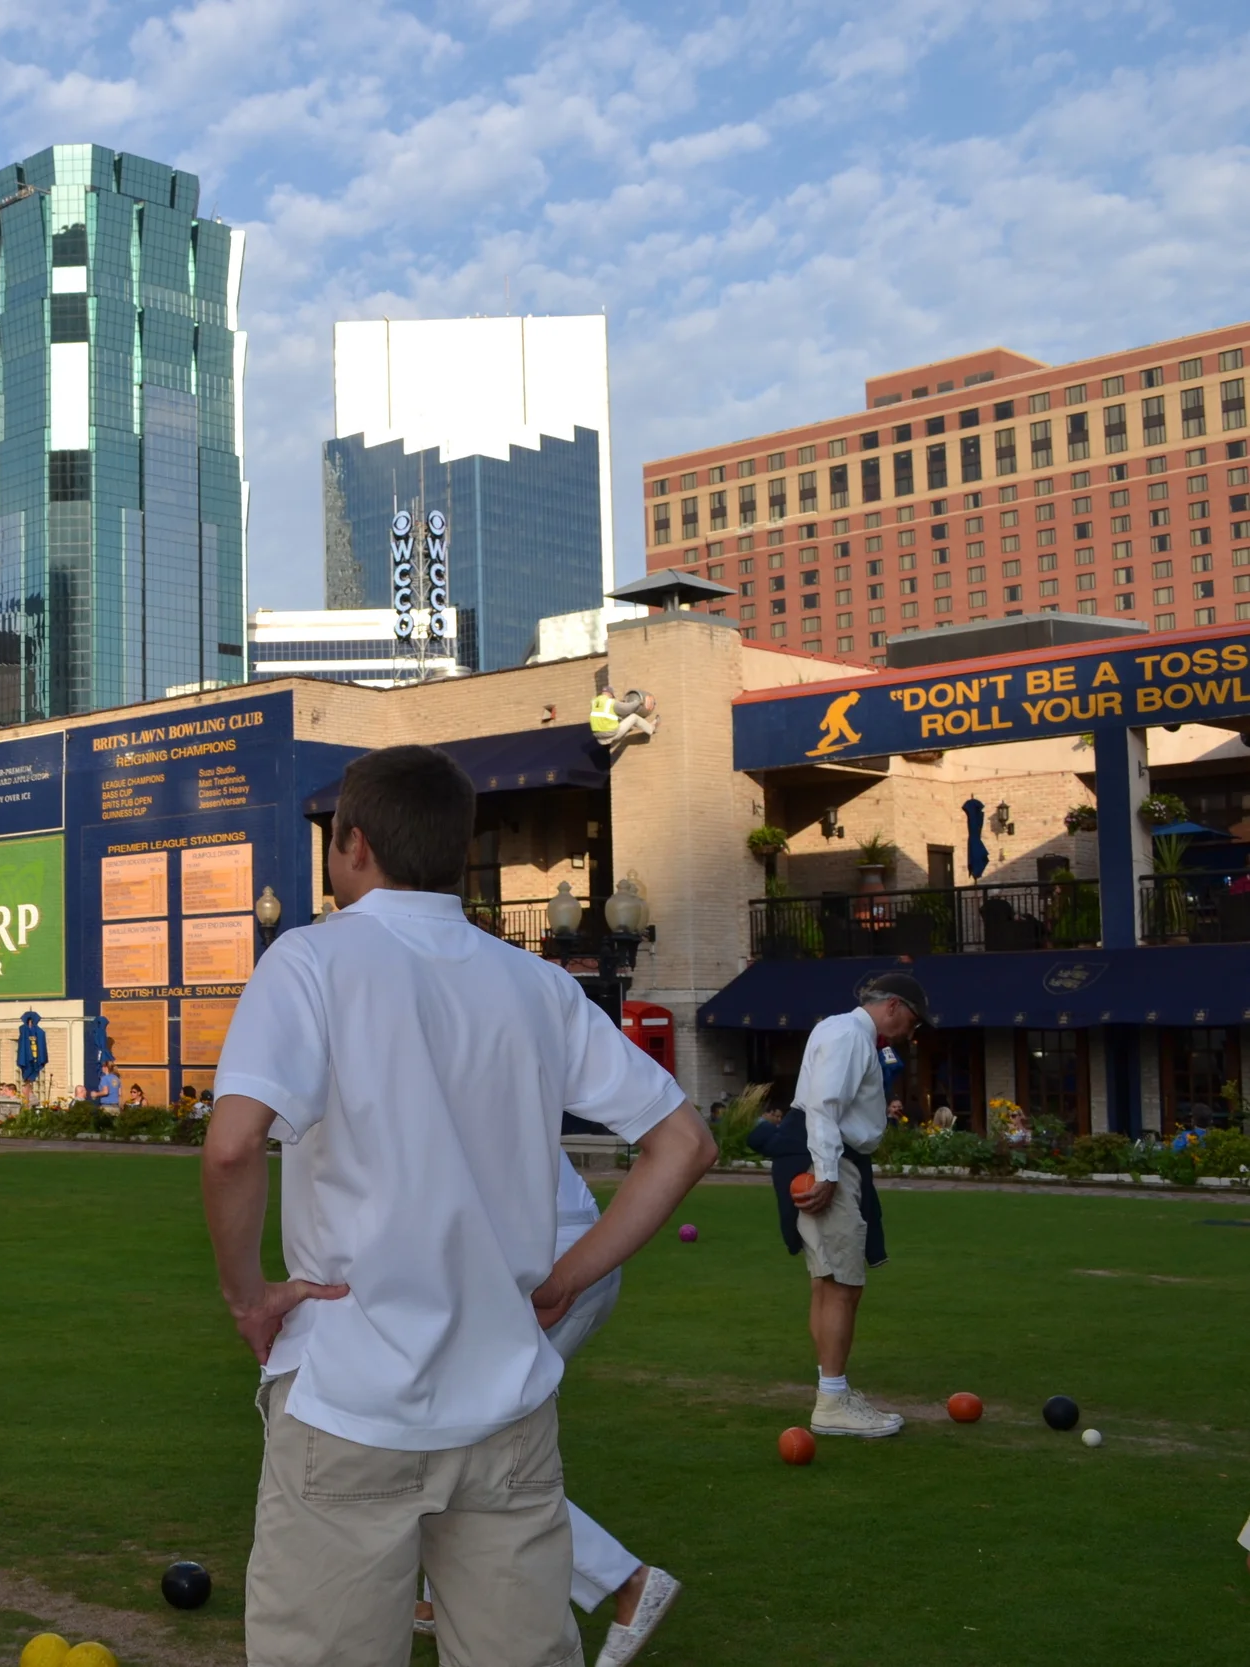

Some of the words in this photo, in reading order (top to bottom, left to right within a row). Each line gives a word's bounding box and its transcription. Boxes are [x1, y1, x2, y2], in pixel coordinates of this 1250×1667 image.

[391, 537, 414, 637] WCCO
[427, 537, 447, 637] WCCO
[1026, 665, 1077, 696] BE
[1092, 661, 1120, 688] A
[1135, 644, 1248, 681] TOSS
[921, 706, 1013, 739] ROLL
[1021, 692, 1124, 726] YOUR
[1136, 677, 1250, 713] BOWL
[93, 733, 128, 752] BRIT'S
[131, 727, 165, 745] LAWN
[169, 717, 226, 740] BOWLING
[229, 711, 264, 730] CLUB
[116, 751, 168, 768] REIGNING
[171, 739, 237, 760] CHAMPIONS
[216, 765, 236, 775] Studio
[102, 779, 126, 790] LEAGUE
[127, 773, 165, 786] CHAMPIONS
[199, 779, 213, 788] Matt
[4, 793, 20, 803] OVER
[21, 792, 31, 800] ICE
[102, 790, 119, 800] BASS
[120, 788, 133, 798] CUP
[199, 788, 221, 798] Classic
[229, 785, 250, 794] Heavy
[121, 798, 133, 807] PUB
[134, 796, 152, 806] OPEN
[102, 809, 133, 820] GUINNESS
[133, 807, 147, 816] CUP
[108, 842, 148, 854] PREMIER
[151, 838, 188, 849] LEAGUE
[190, 831, 246, 845] STANDINGS
[110, 988, 153, 999] SCOTTISH
[156, 987, 192, 997] LEAGUE
